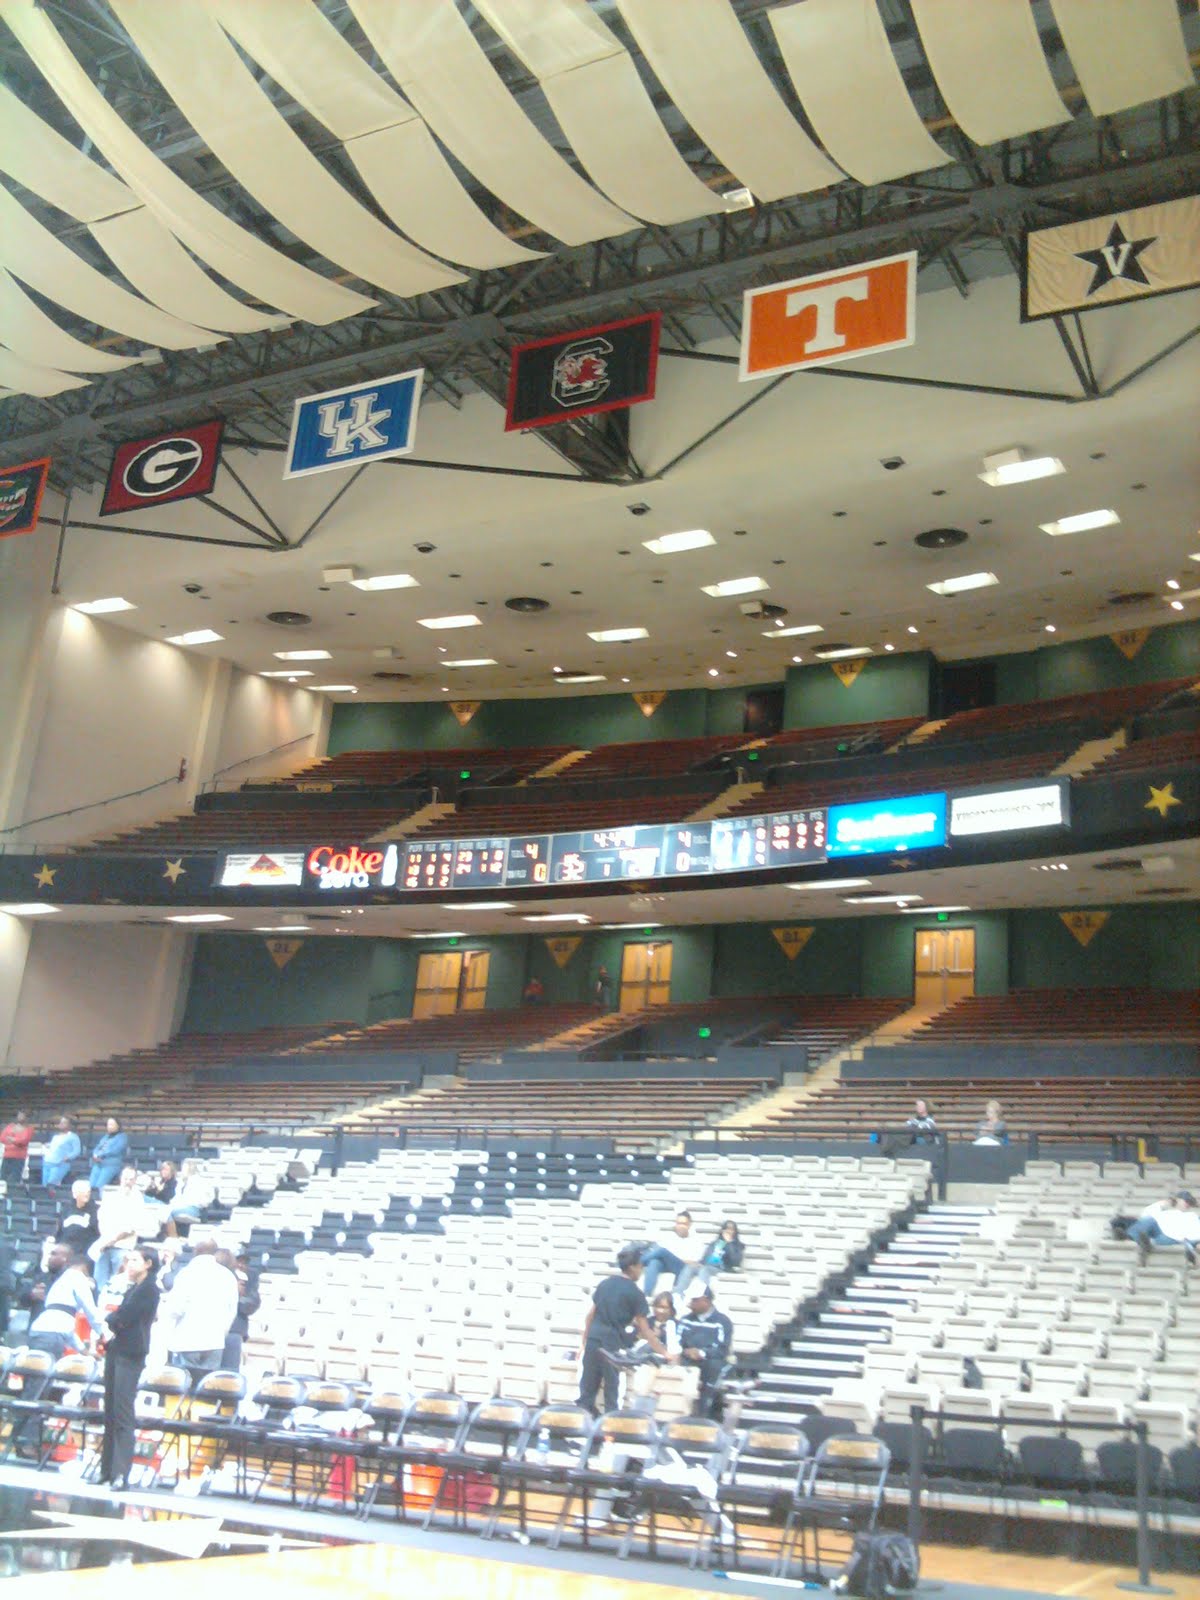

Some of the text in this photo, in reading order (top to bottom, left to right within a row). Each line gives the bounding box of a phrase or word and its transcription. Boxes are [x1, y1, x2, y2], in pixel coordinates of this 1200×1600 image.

[1101, 243, 1131, 275] V
[785, 276, 868, 354] T
[318, 393, 391, 457] UK
[123, 438, 202, 497] G
[526, 843, 538, 860] 4
[678, 831, 692, 848] 4
[307, 846, 384, 876] Coke
[534, 863, 547, 882] 0
[676, 851, 690, 872] 0
